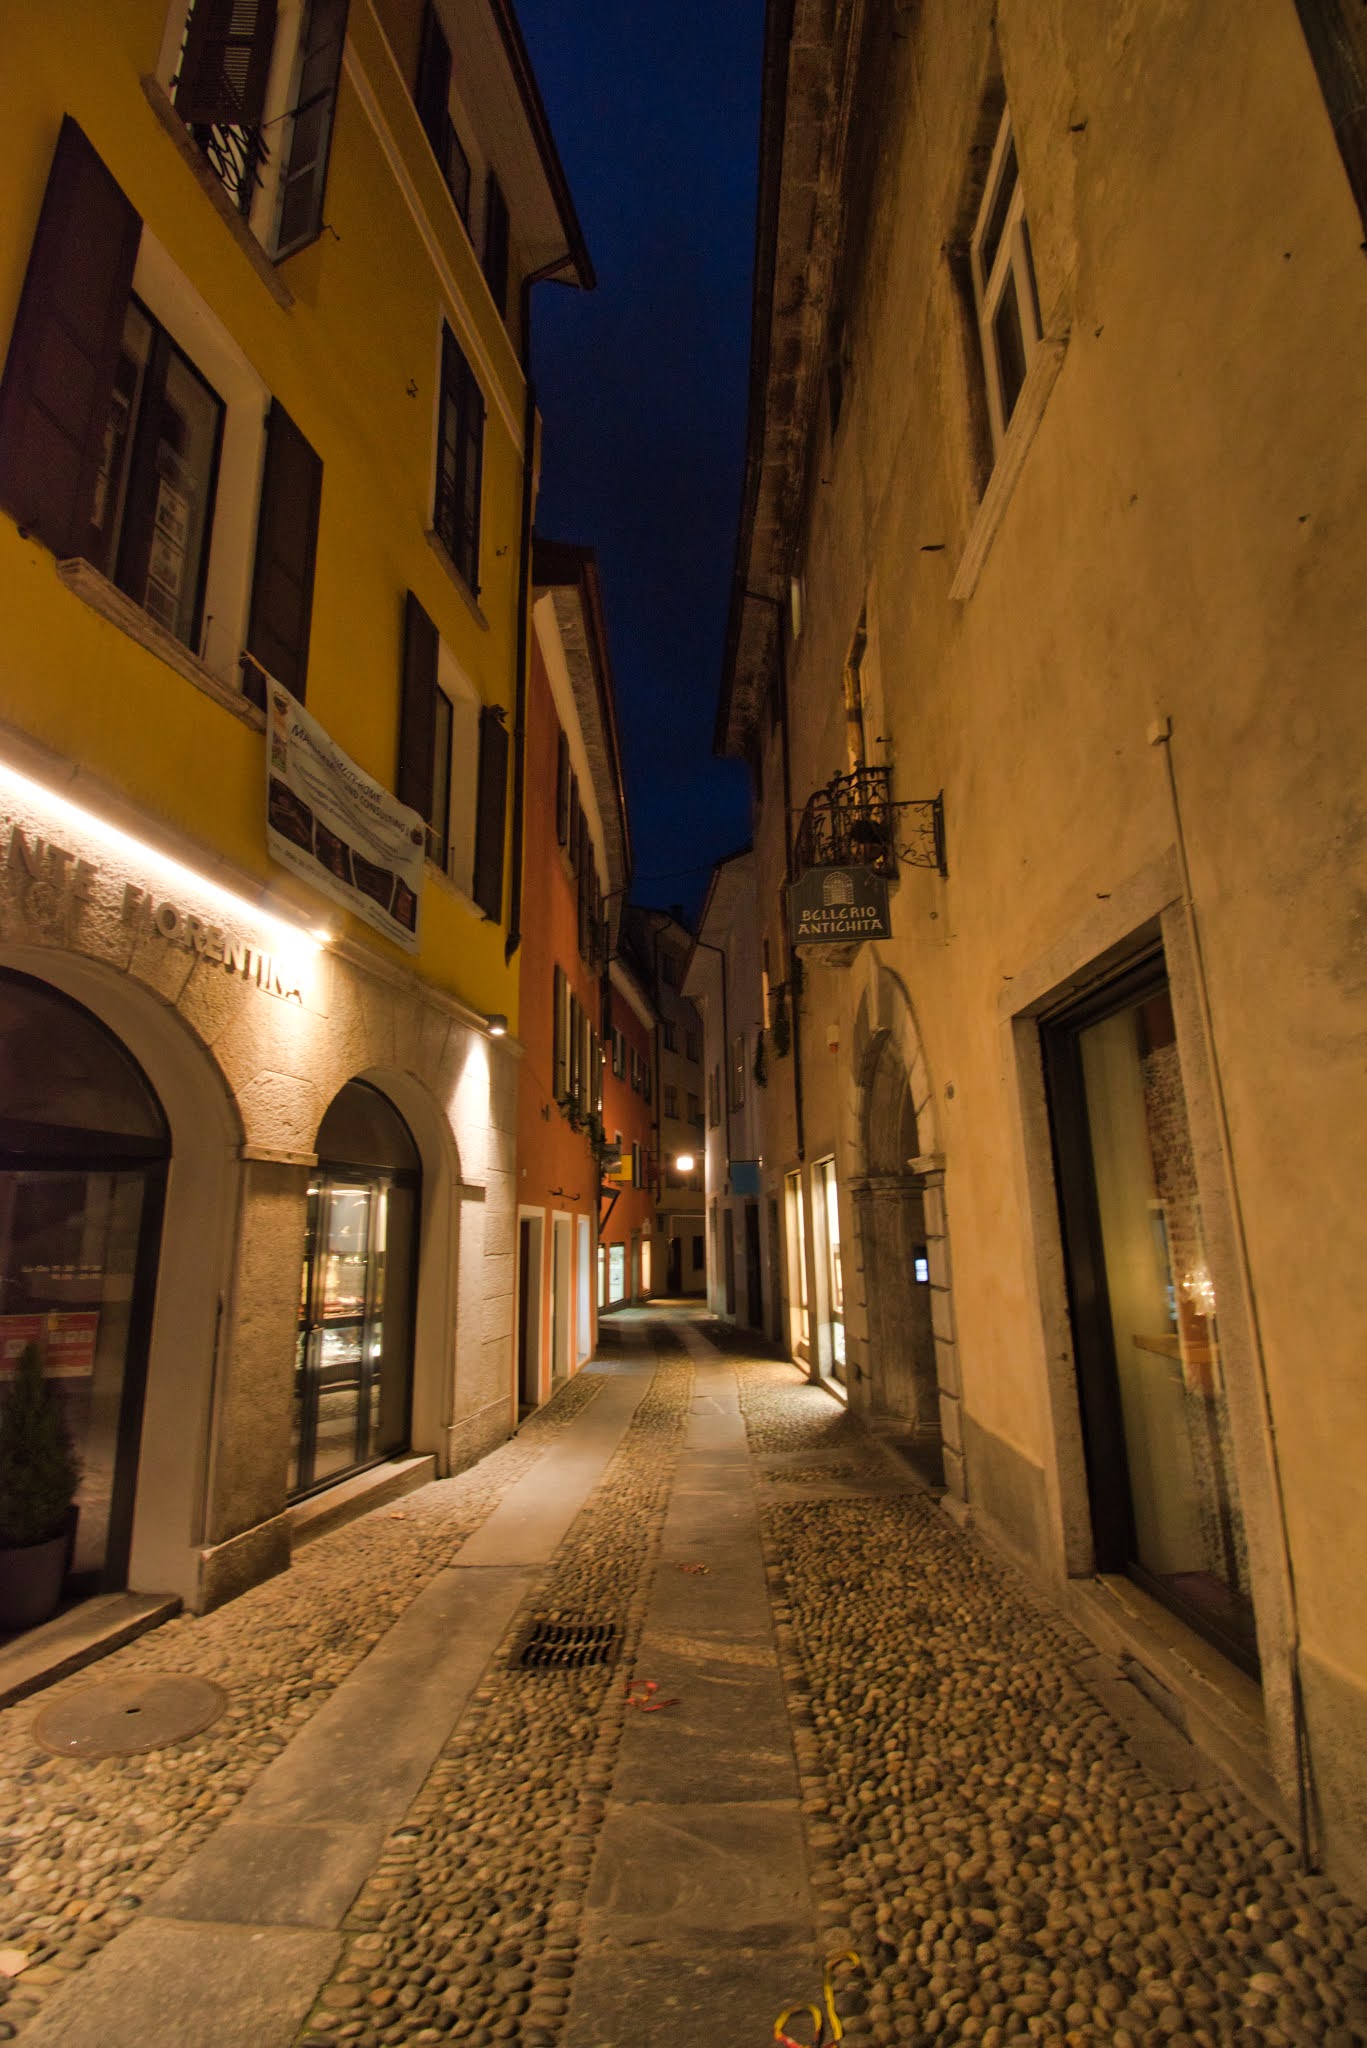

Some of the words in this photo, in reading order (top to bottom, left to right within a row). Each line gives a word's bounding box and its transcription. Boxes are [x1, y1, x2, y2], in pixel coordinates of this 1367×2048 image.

[801, 906, 876, 921] BELLERIO
[798, 919, 883, 934] ANTICHITA
[121, 882, 303, 1005] FIORENTINA
